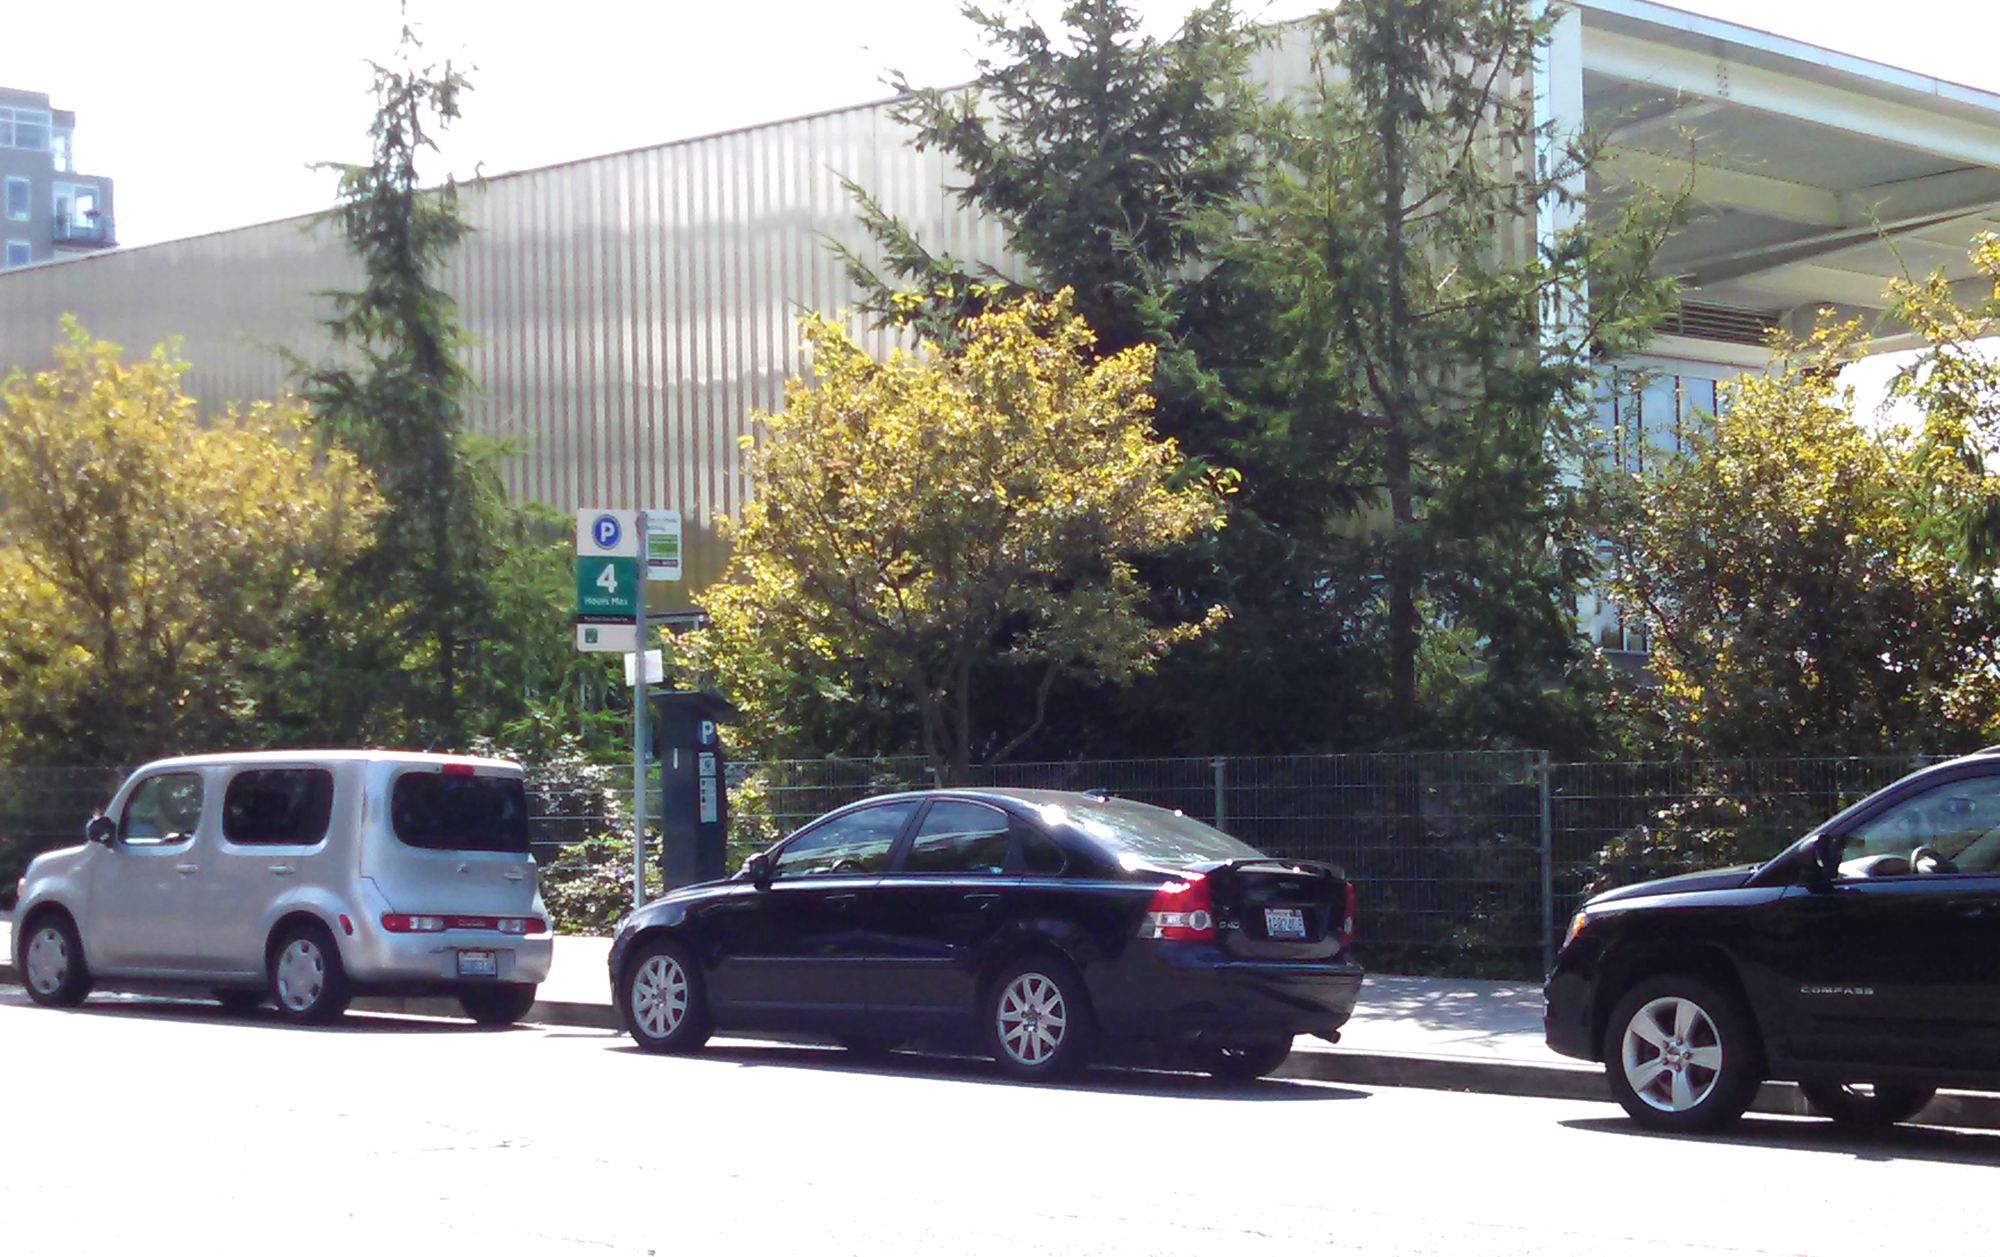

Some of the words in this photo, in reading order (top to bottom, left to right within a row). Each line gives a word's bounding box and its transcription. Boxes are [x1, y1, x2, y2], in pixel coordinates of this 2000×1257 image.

[600, 521, 616, 543] P
[595, 563, 618, 594] 4
[583, 596, 610, 606] Hours
[701, 720, 714, 745] P
[1800, 985, 1875, 995] COMPASS
